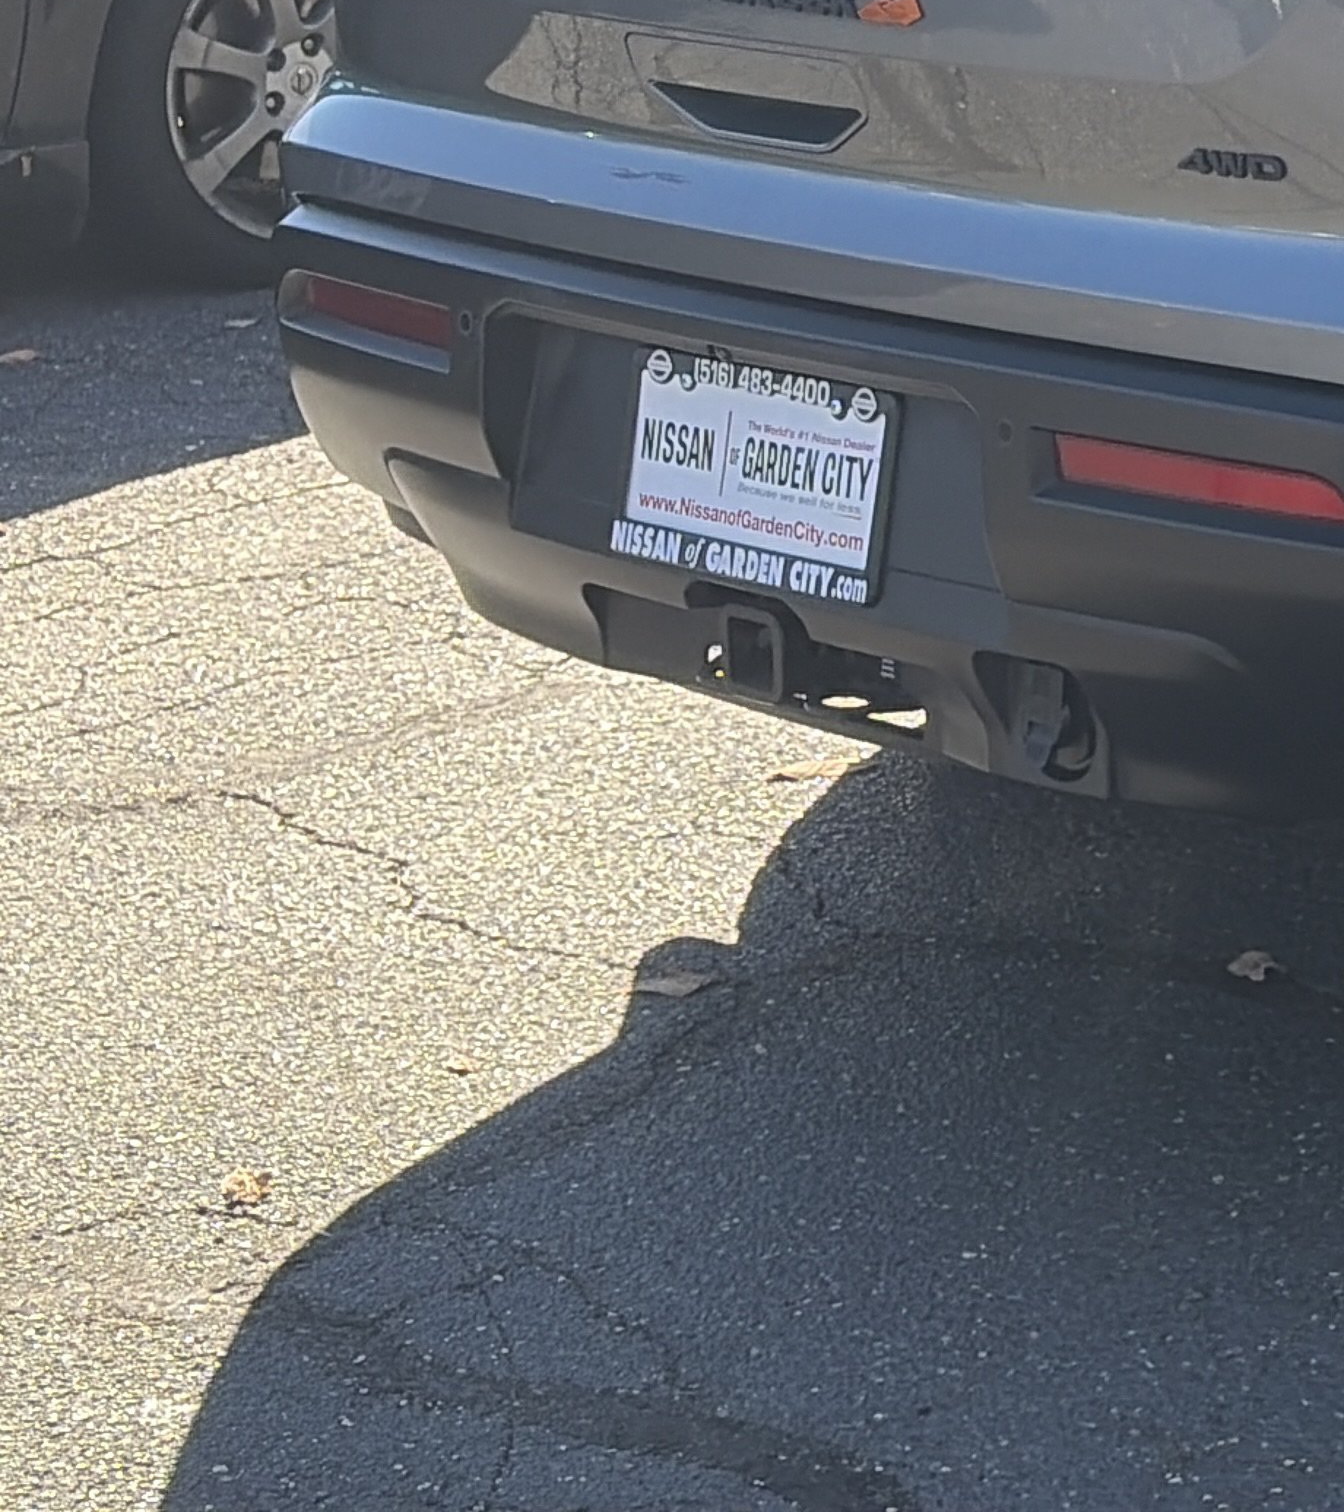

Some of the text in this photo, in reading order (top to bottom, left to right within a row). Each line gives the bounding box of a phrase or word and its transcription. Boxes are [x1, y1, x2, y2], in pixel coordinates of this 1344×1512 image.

[1177, 147, 1288, 182] AWD
[693, 356, 831, 408] (516) 483-4400
[641, 417, 716, 473] NISSAN
[729, 447, 741, 466] OF
[741, 436, 874, 502] GARDEN CITY
[638, 491, 865, 552] www.NissanofGardenCity.com
[610, 518, 869, 605] NISSAN of GARDEN CITY.com
